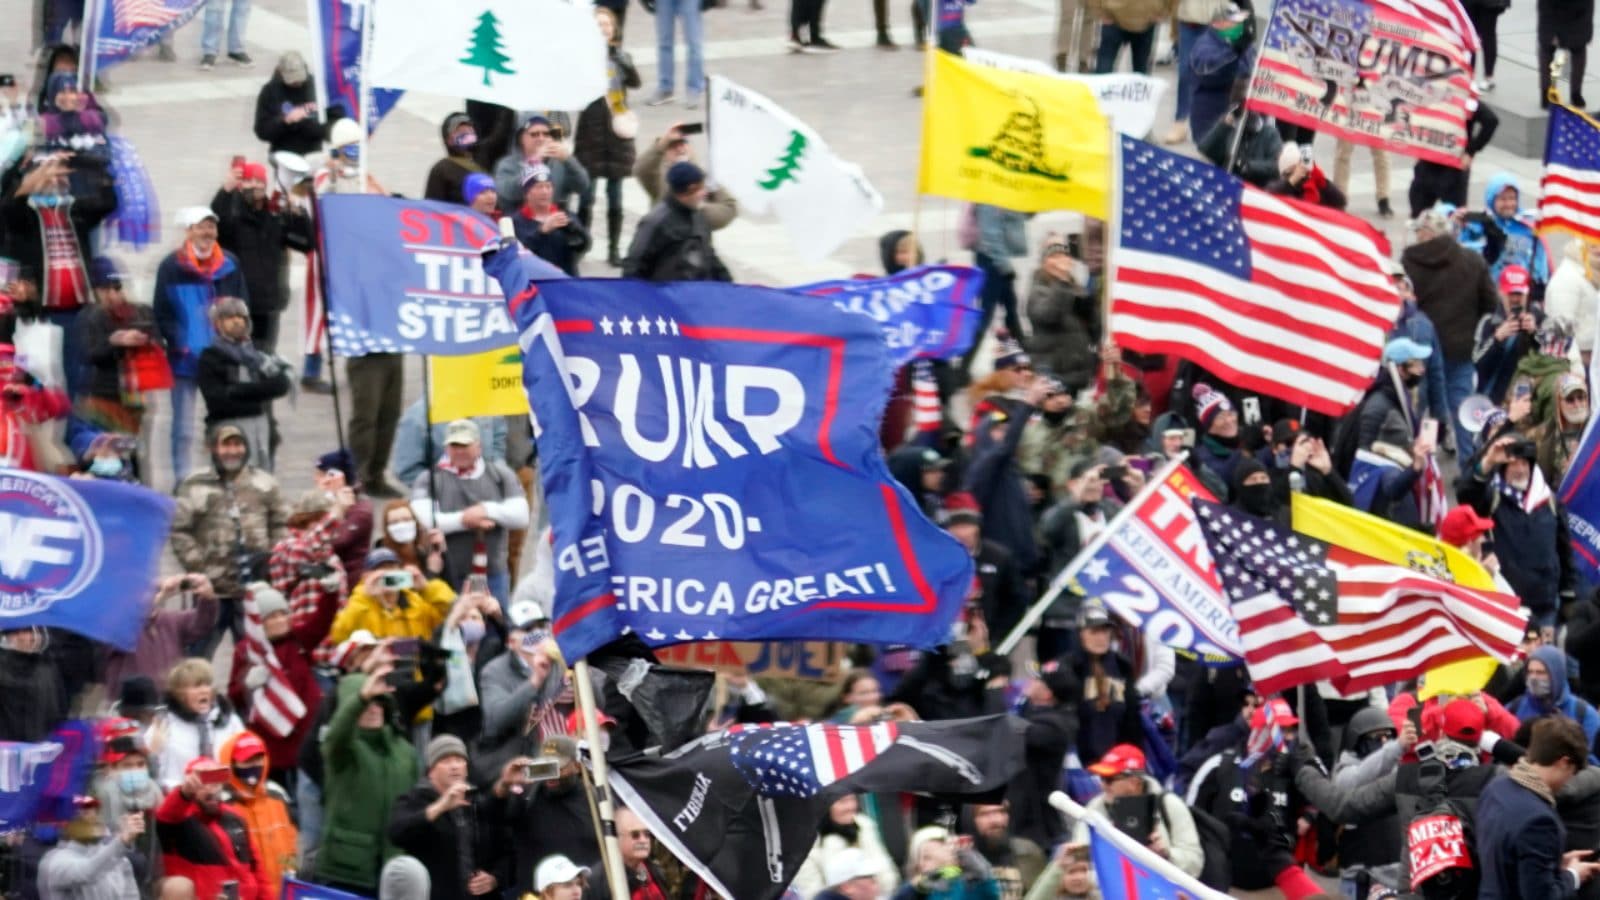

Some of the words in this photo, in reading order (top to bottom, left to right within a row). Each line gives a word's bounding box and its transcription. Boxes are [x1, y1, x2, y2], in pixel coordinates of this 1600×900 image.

[400, 207, 499, 249] STO
[1118, 521, 1170, 572] KEEP
[744, 562, 897, 613] GREAT!
